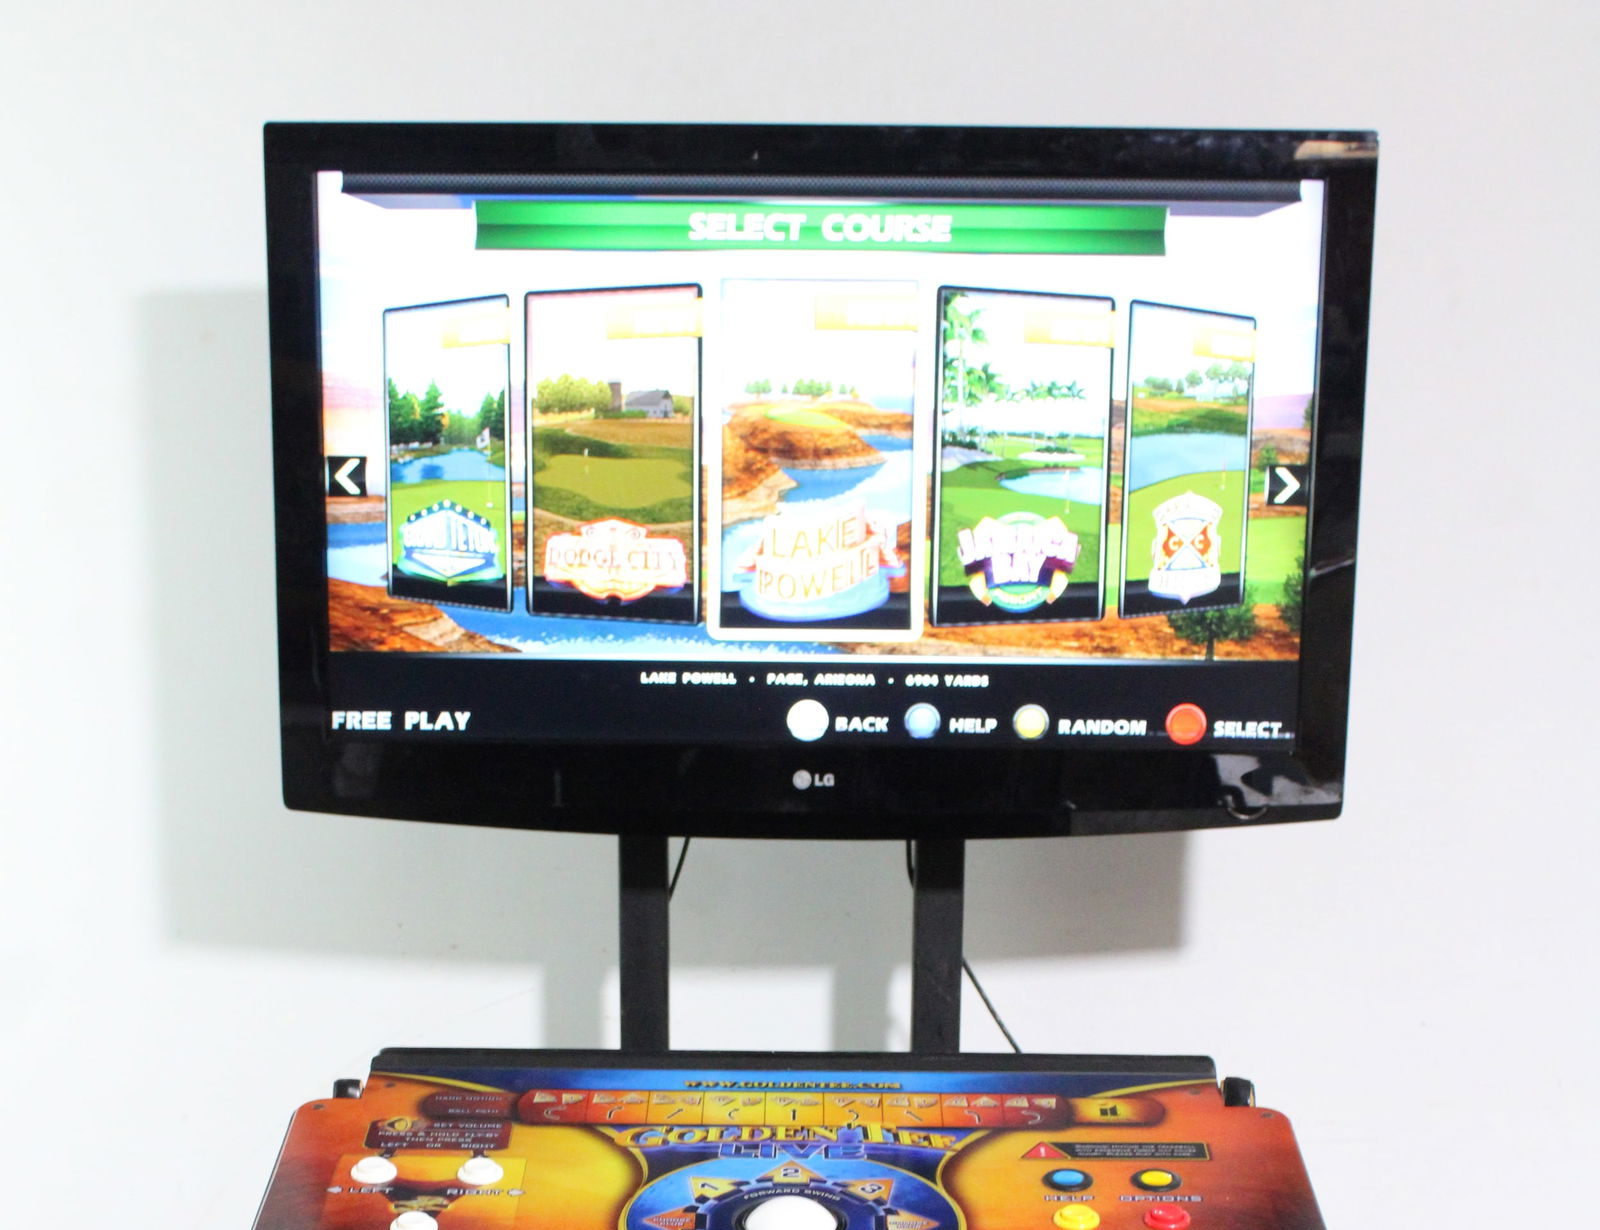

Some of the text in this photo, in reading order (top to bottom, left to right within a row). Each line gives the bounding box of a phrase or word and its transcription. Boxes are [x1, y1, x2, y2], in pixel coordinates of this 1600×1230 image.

[687, 211, 953, 243] SELECT COURSE
[627, 549, 678, 571] CITY
[640, 671, 678, 685] LAKE
[681, 671, 737, 685] POWELL
[813, 673, 876, 687] ARIZONA
[943, 673, 990, 688] YARDS
[331, 711, 472, 731] FREE PLAY
[834, 716, 890, 733] BACK
[949, 717, 999, 734] HELP
[1056, 718, 1148, 736] RANDOM
[813, 772, 836, 787] LG
[625, 1124, 839, 1148] GOLDEN
[718, 1143, 868, 1160] LIVE
[349, 1186, 395, 1194] LEFT
[446, 1188, 504, 1196] RIGHT
[743, 1187, 842, 1202] FORWARD SWING
